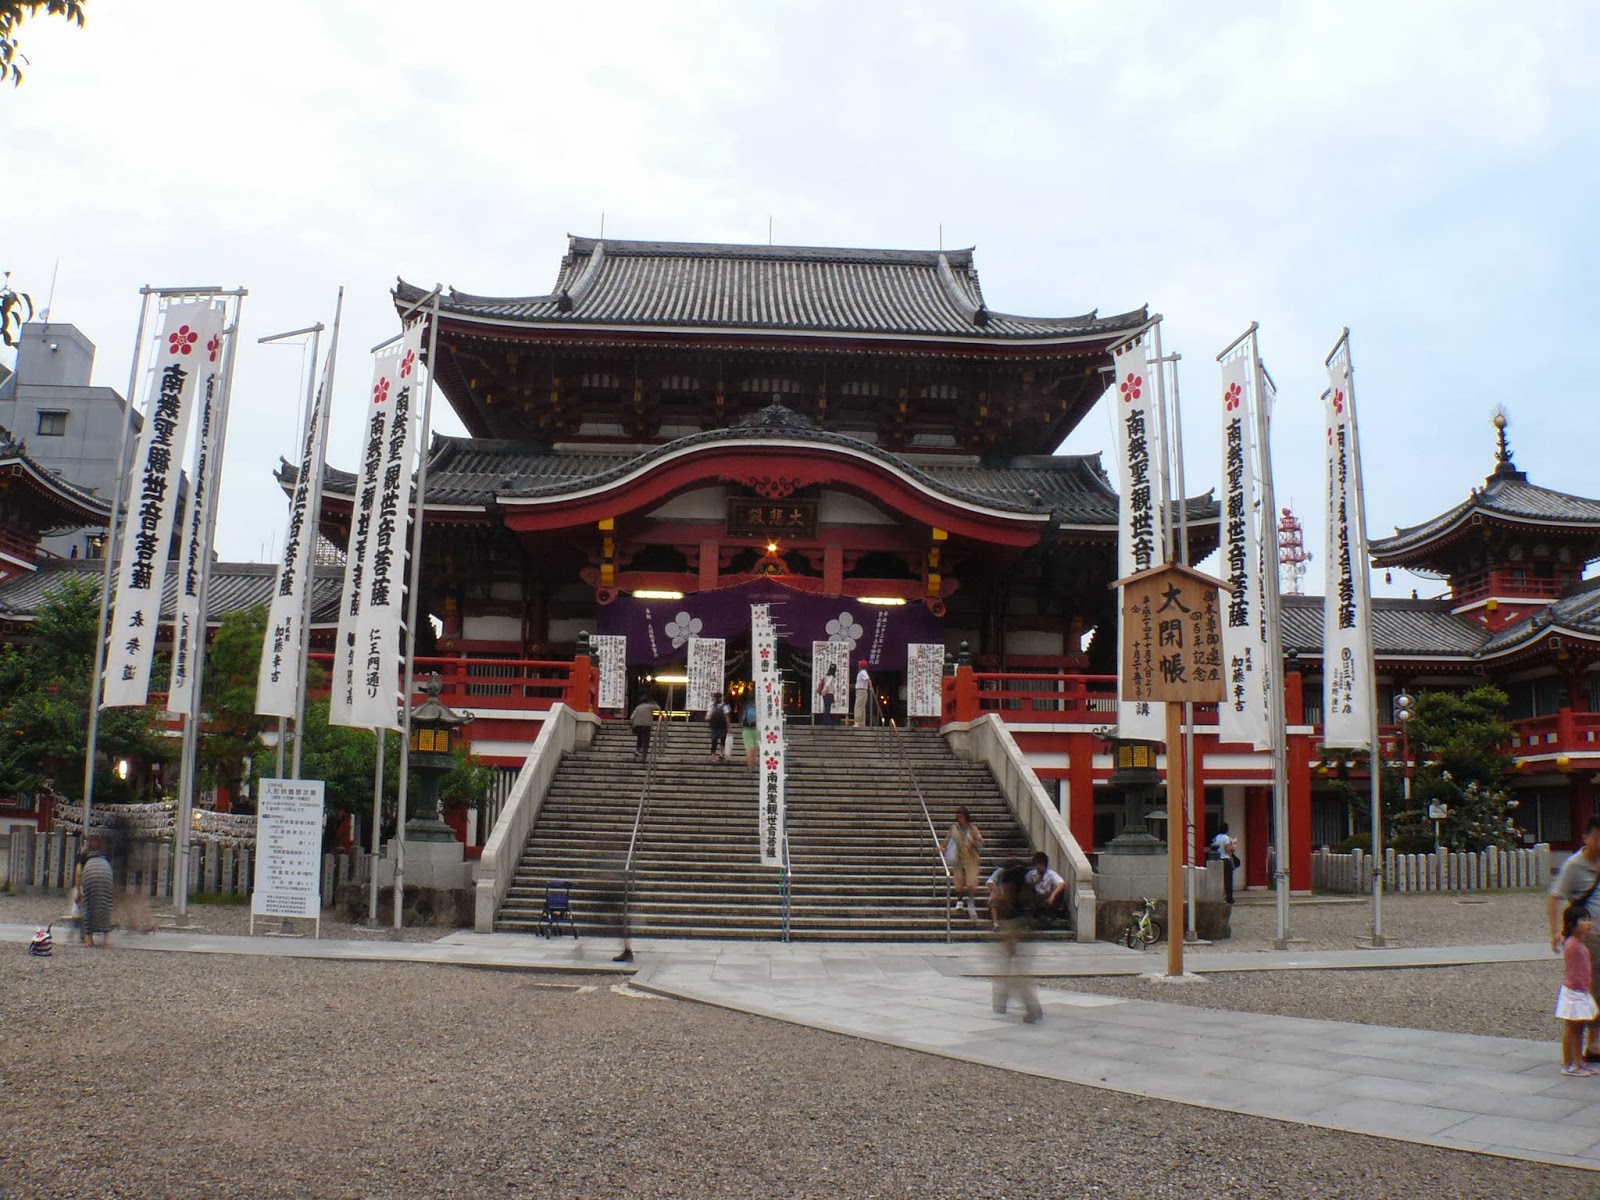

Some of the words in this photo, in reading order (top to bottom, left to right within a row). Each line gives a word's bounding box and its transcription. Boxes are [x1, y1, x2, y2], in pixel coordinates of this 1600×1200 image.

[371, 386, 410, 606] 南無聖観世音菩薩
[271, 624, 284, 682] 加藤幸吉
[366, 628, 382, 698] 仁王門通り
[1157, 582, 1191, 684] 大開帳
[1190, 612, 1207, 682] 四百年記念
[1231, 655, 1246, 712] 加藤幸吉
[766, 771, 778, 858] 南無聖観世音菩薩
